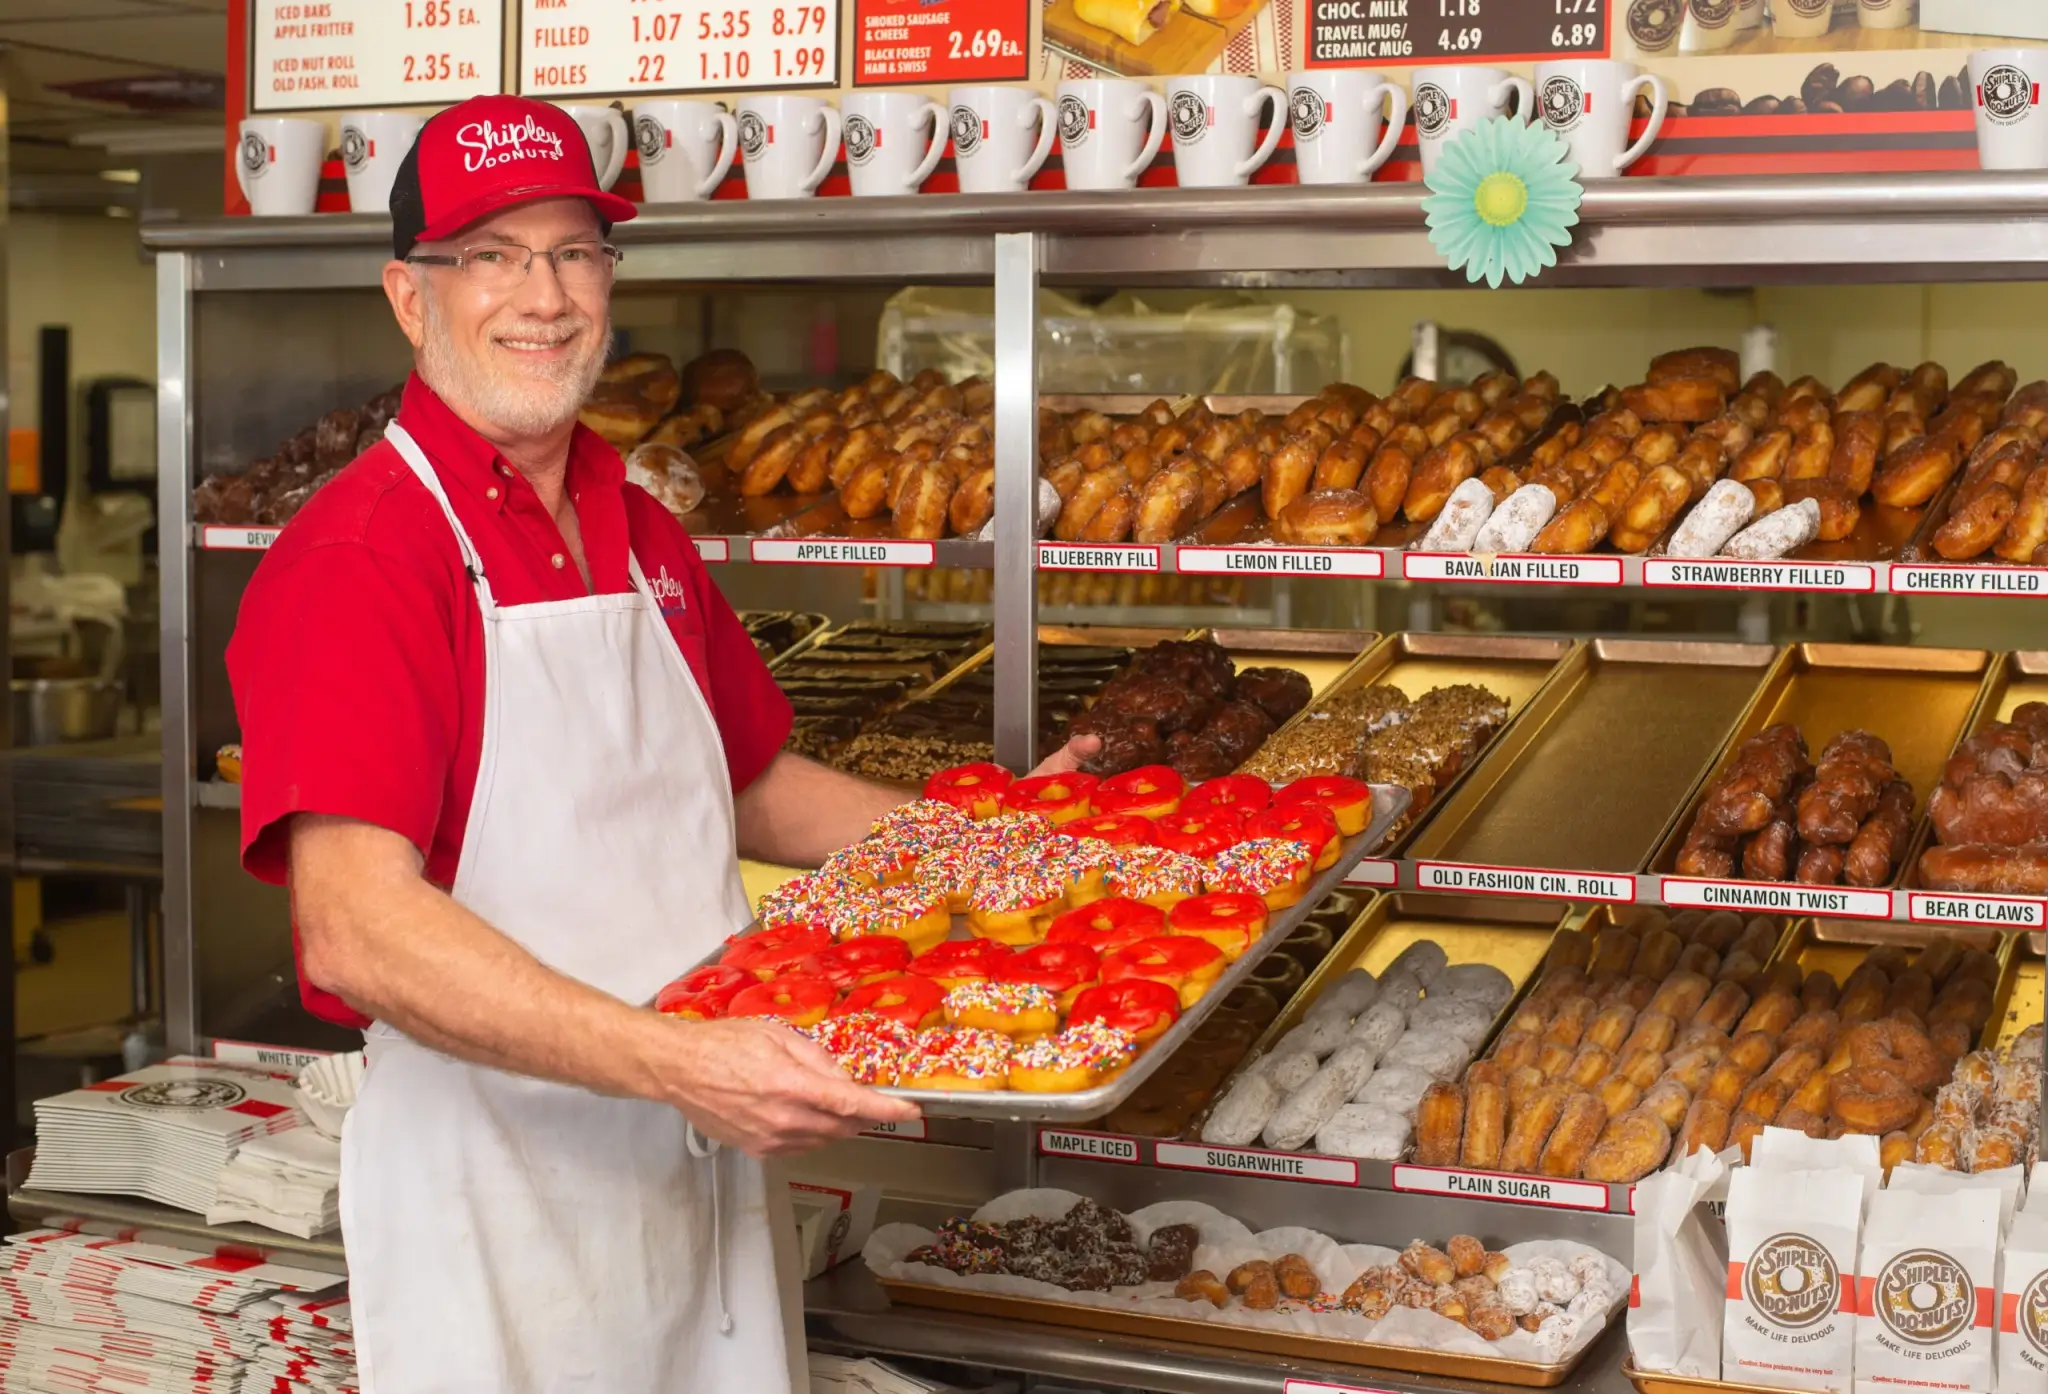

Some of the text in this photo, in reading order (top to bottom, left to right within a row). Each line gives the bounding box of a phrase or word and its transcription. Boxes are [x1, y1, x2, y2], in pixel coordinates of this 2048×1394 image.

[275, 4, 332, 20] ICED BARS
[404, 0, 480, 28] 1.85 EA.
[865, 12, 950, 28] SMOKED SAUSAGE
[1317, 0, 1408, 20] CHOC. MILK
[274, 22, 354, 39] APPLE FRITTER
[535, 6, 826, 48] FILLED 1.07 5.35 8.79
[874, 28, 909, 41] CHEESE
[1316, 23, 1408, 41] TRAVEL MUG/
[1551, 23, 1597, 47] 6.89
[948, 29, 1023, 59] 2.69 EA.
[1316, 40, 1413, 58] CERAMIC MUG
[1438, 28, 1482, 50] 4.69
[865, 46, 932, 61] BLACK FOREST
[273, 56, 355, 73] ICED NUT ROLL
[404, 54, 480, 83] 2.35 EA.
[534, 47, 825, 86] HOLES .22 1.10 1.99
[864, 63, 887, 75] HAM
[897, 60, 927, 73] SWISS
[273, 78, 295, 92] OLD
[332, 75, 359, 89] ROLL
[1986, 73, 2023, 92] SHIPLEY
[456, 114, 563, 172] Shipley
[485, 148, 559, 168] DONUTS
[797, 544, 886, 561] APPLE FILLED
[1041, 550, 1157, 567] BLUEBERRY FILL
[1226, 554, 1332, 571] LEMON FILLED
[1526, 562, 1579, 579] FILLED
[1671, 565, 1845, 585] STRAWBERRY FILLED
[1907, 572, 2039, 591] CHERRY FILLED
[1433, 869, 1618, 897] OLD FASHION CIN. ROLL
[1703, 886, 1849, 911] CINNAMON TWIST
[1926, 900, 2034, 922] BEAR CLAWS
[257, 1050, 293, 1066] WHITE
[1051, 1134, 1133, 1157] MAPLE ICED
[1206, 1151, 1304, 1175] SUGARWHITE
[1448, 1175, 1551, 1200] PLAIN SUGAR
[1759, 1247, 1826, 1275] SHIPLEY
[1888, 1263, 1960, 1292] SHIPLEY
[1745, 1316, 1835, 1344] MAKE LIFE DELICIOUS
[1876, 1333, 1972, 1360] MAKE LIFE DELICIOUS
[2020, 1350, 2045, 1371] MAKE
